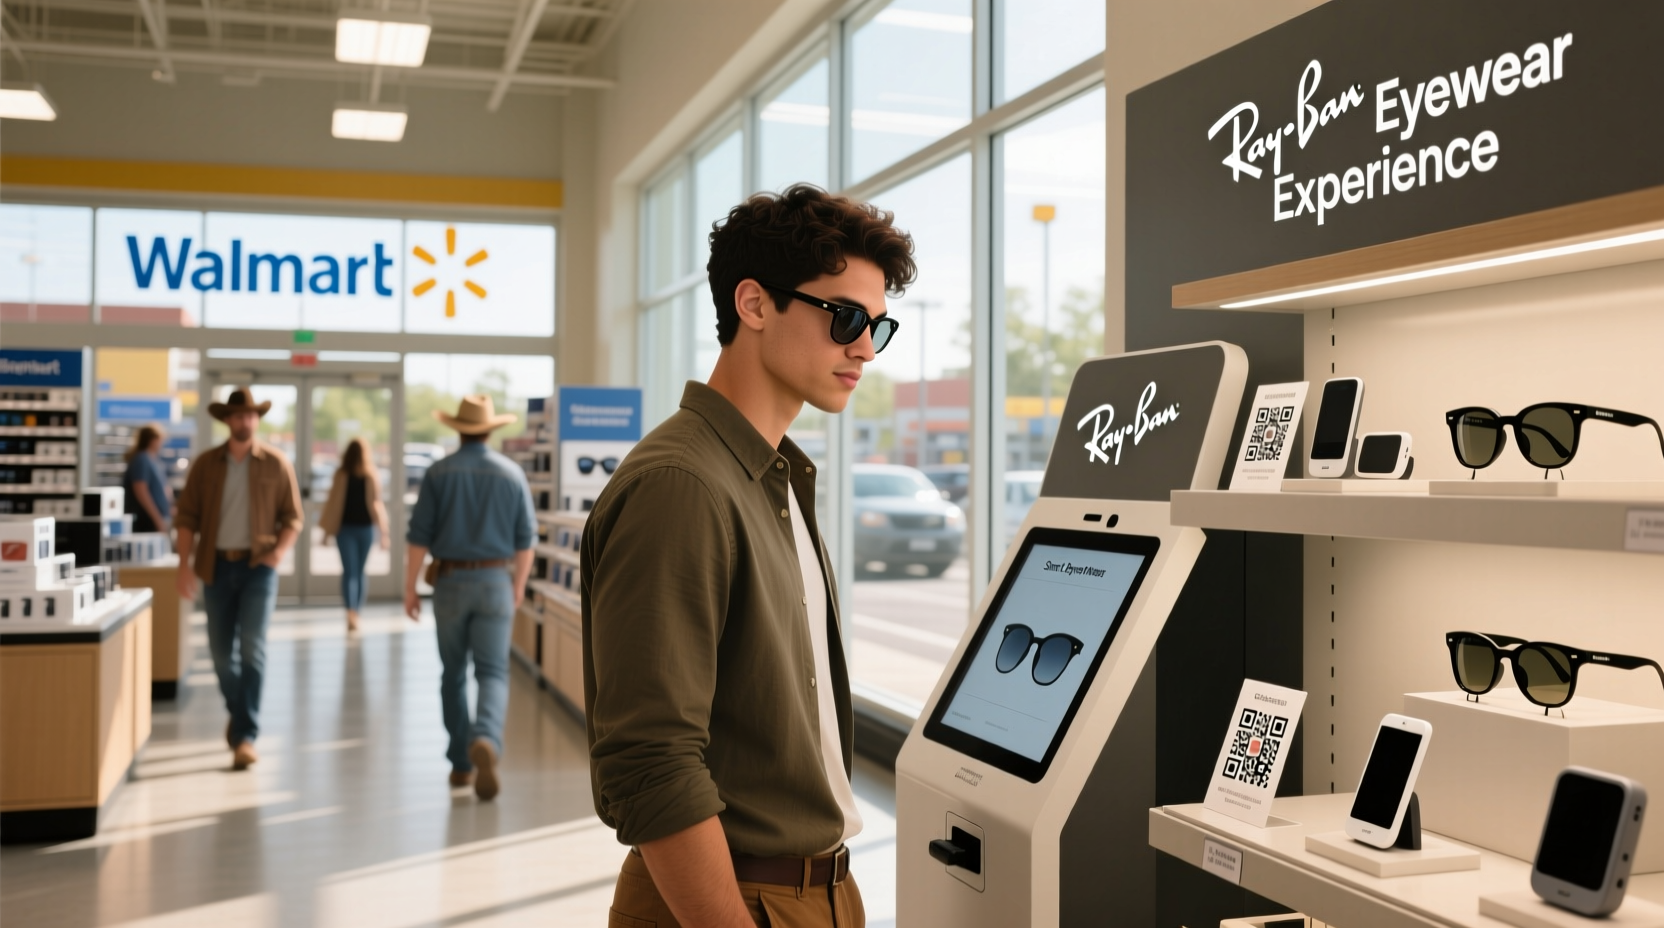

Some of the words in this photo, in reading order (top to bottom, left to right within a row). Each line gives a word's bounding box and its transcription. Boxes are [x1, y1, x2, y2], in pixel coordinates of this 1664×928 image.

[1375, 32, 1573, 141] Eyewear
[1273, 129, 1500, 226] Experience
[126, 235, 394, 298] Walmart
